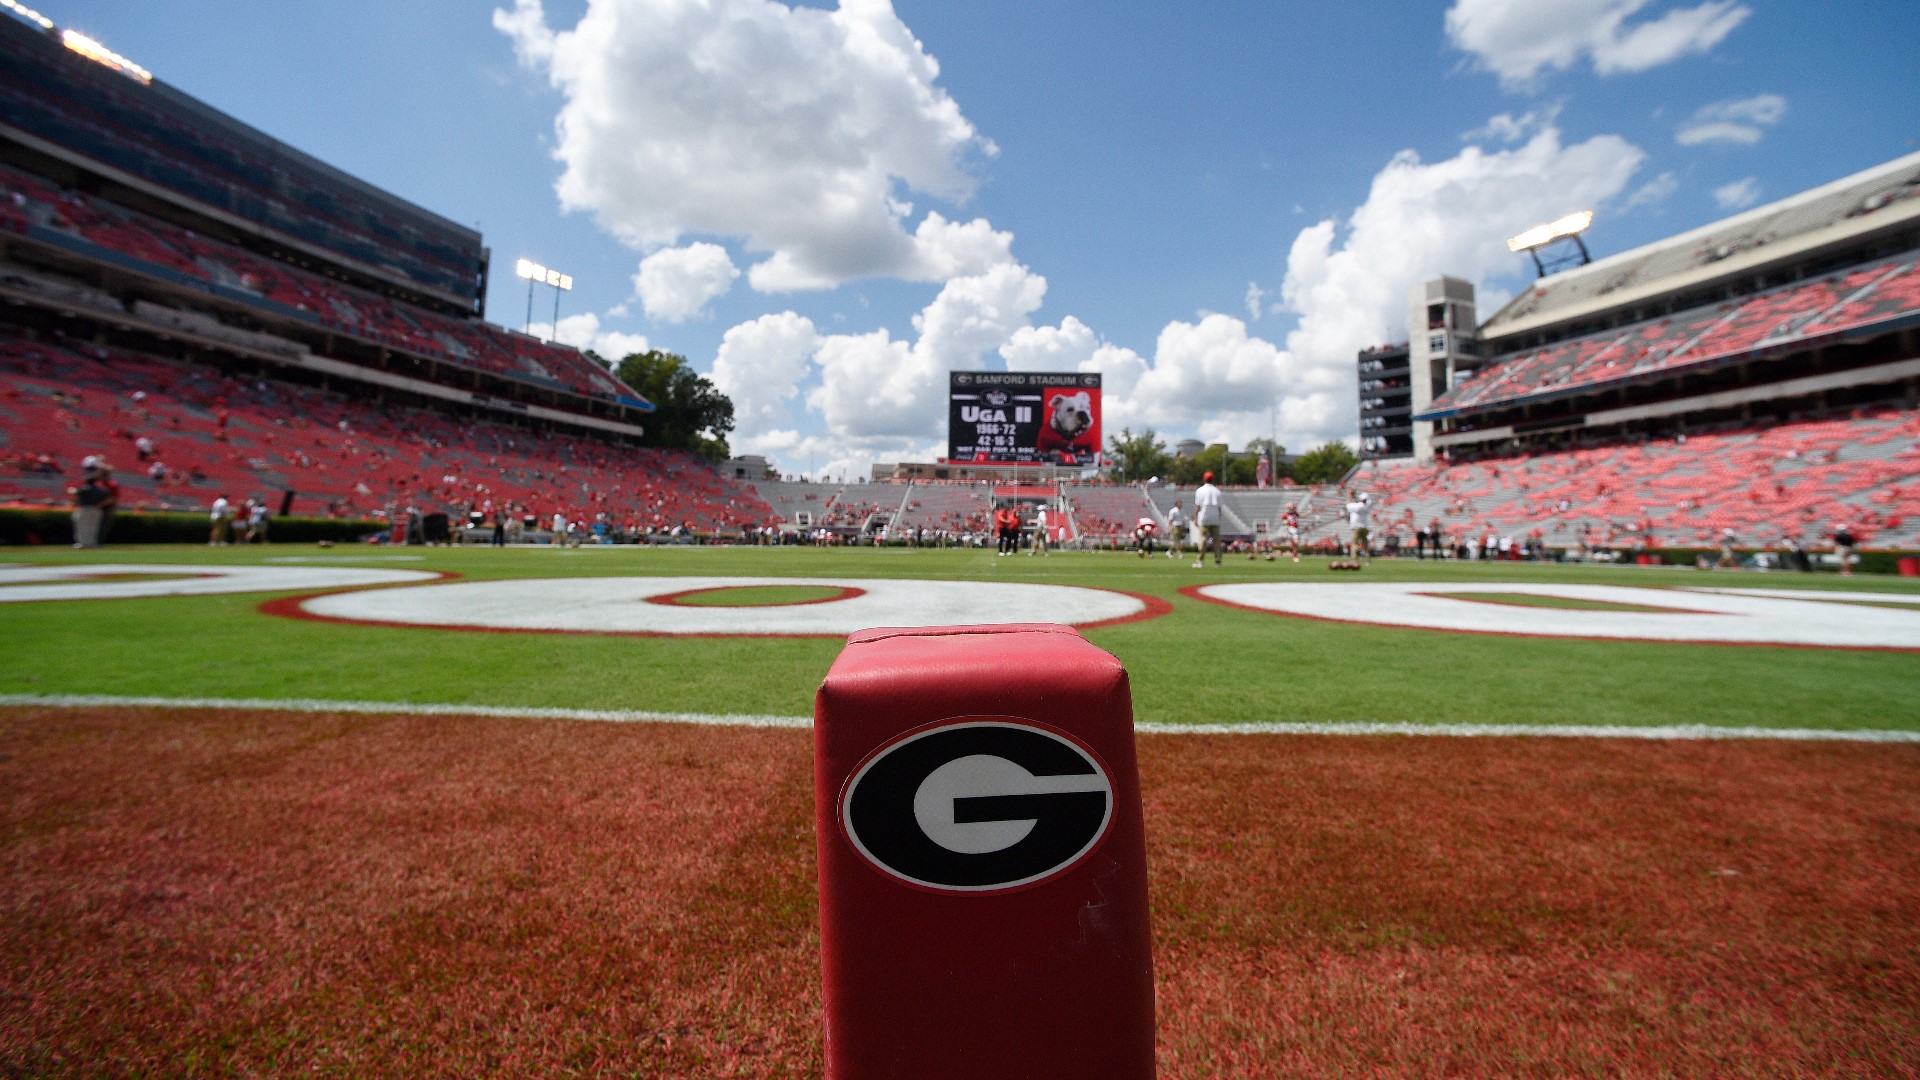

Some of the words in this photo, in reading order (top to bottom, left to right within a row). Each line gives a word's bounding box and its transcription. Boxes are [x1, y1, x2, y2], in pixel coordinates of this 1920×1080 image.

[976, 375, 1025, 385] SANFORD
[1029, 376, 1076, 385] STADIUM
[1015, 406, 1032, 423] II
[976, 424, 1016, 435] 1966-72
[847, 725, 1108, 888] G
